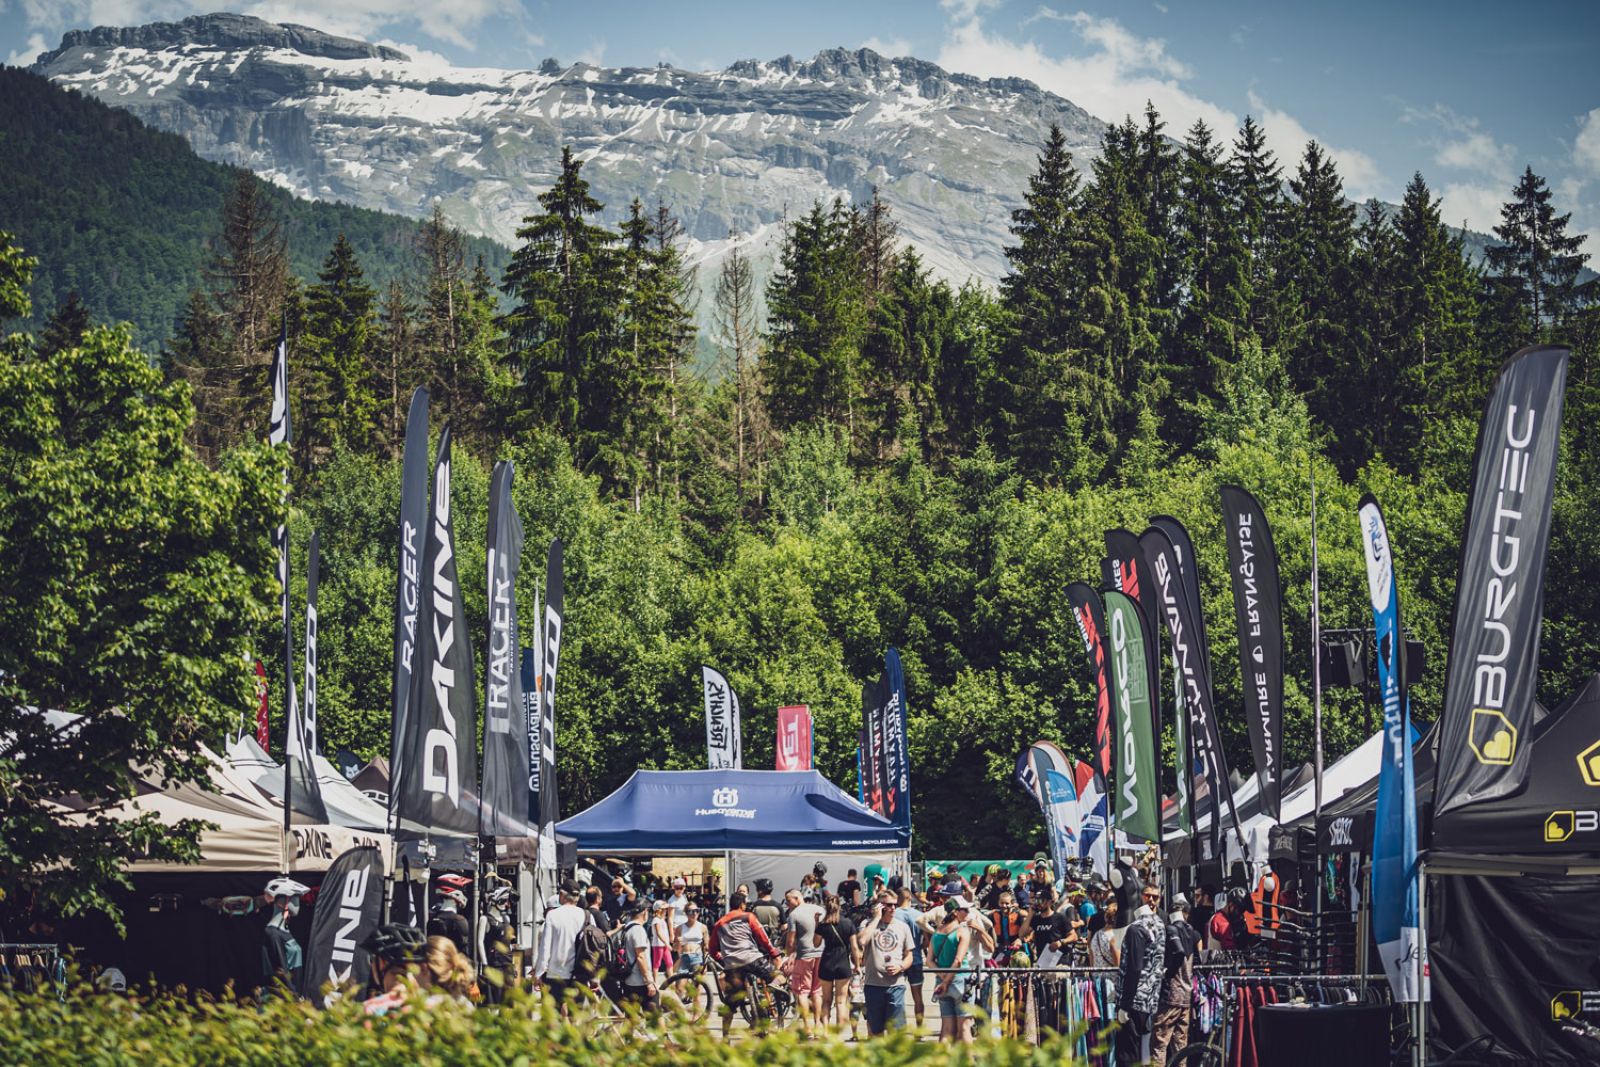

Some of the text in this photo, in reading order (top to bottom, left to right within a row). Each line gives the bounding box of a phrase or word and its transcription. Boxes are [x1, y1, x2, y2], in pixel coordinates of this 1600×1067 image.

[402, 520, 417, 675] RACER
[1474, 405, 1535, 708] BURGTEC
[488, 577, 510, 709] RACER
